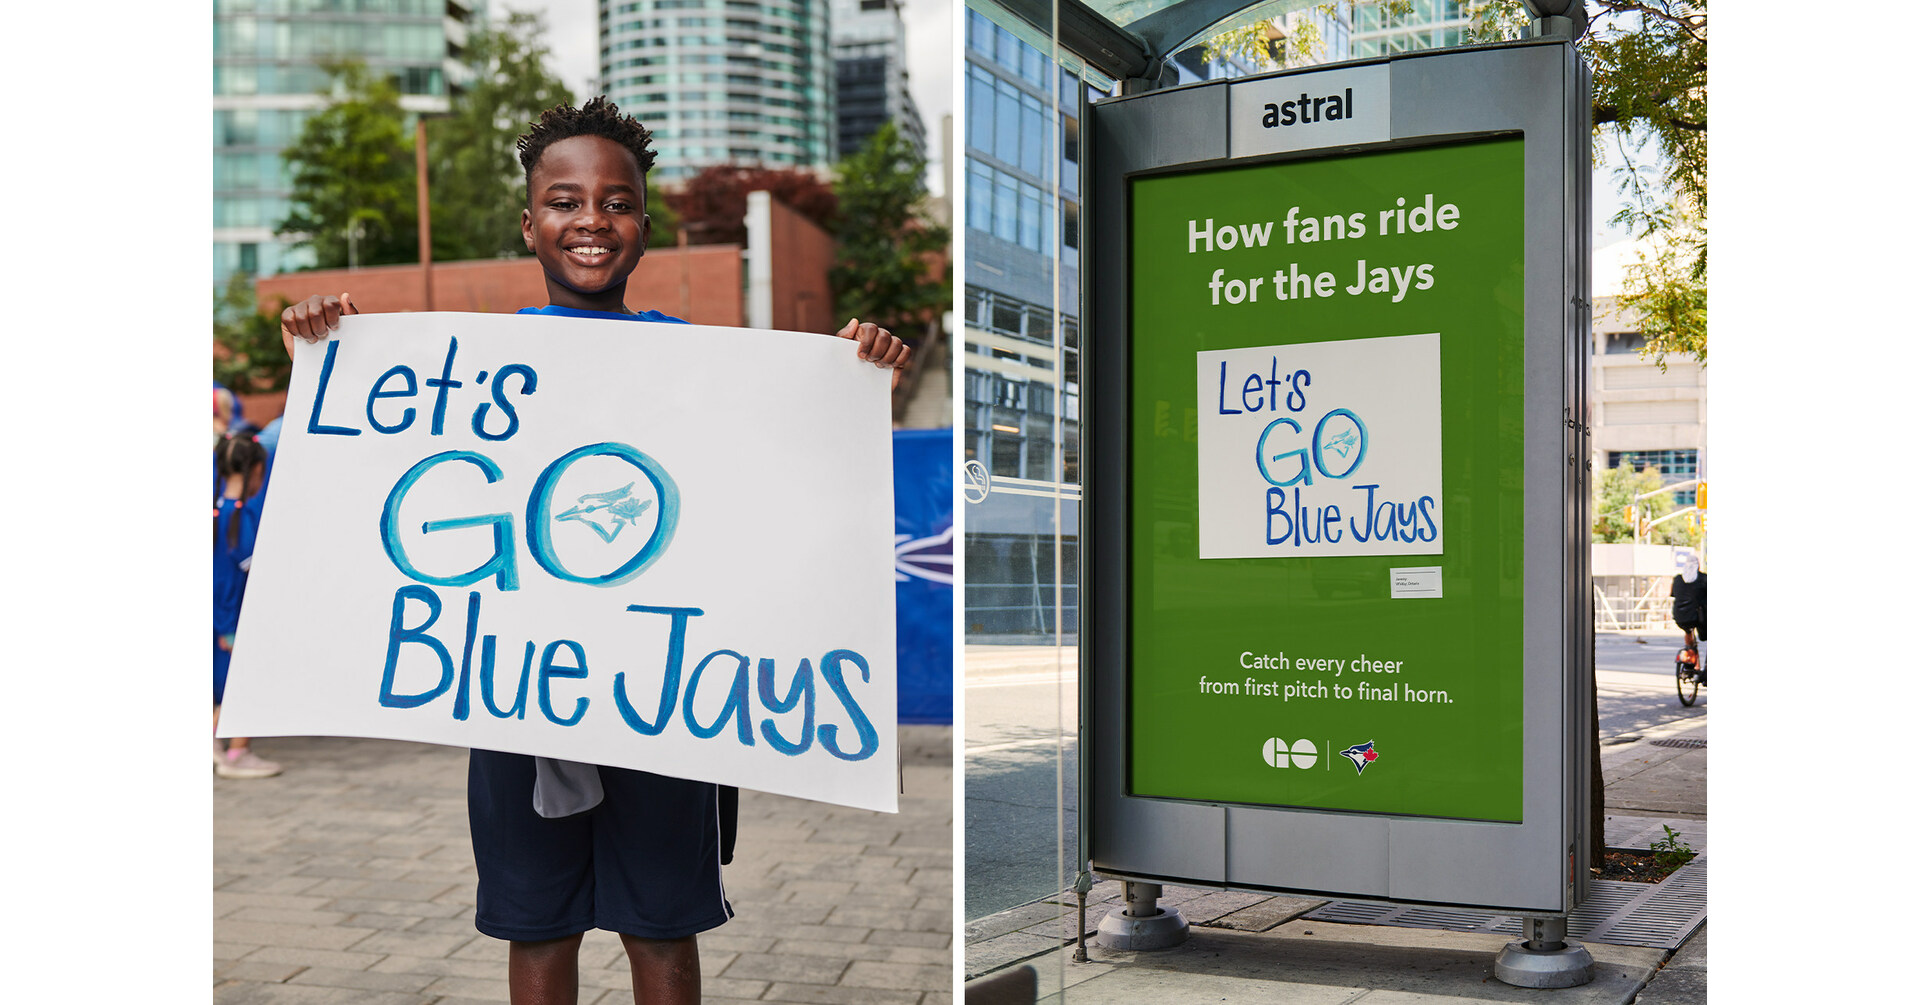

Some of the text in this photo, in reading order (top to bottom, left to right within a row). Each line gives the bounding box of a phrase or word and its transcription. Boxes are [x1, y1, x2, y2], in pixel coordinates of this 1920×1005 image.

[1262, 88, 1353, 128] astral
[1188, 194, 1460, 253] How fans ride
[1208, 259, 1435, 306] for the Jays
[307, 336, 538, 441] Let's
[1219, 355, 1311, 415] Let's
[1256, 408, 1369, 487] GO
[379, 441, 682, 592] GO
[1266, 484, 1438, 547] Blue Jays
[378, 585, 880, 762] Blue Jays
[1199, 675, 1454, 704] from first pitch to final horn.
[1239, 651, 1404, 677] Catch every cheer
